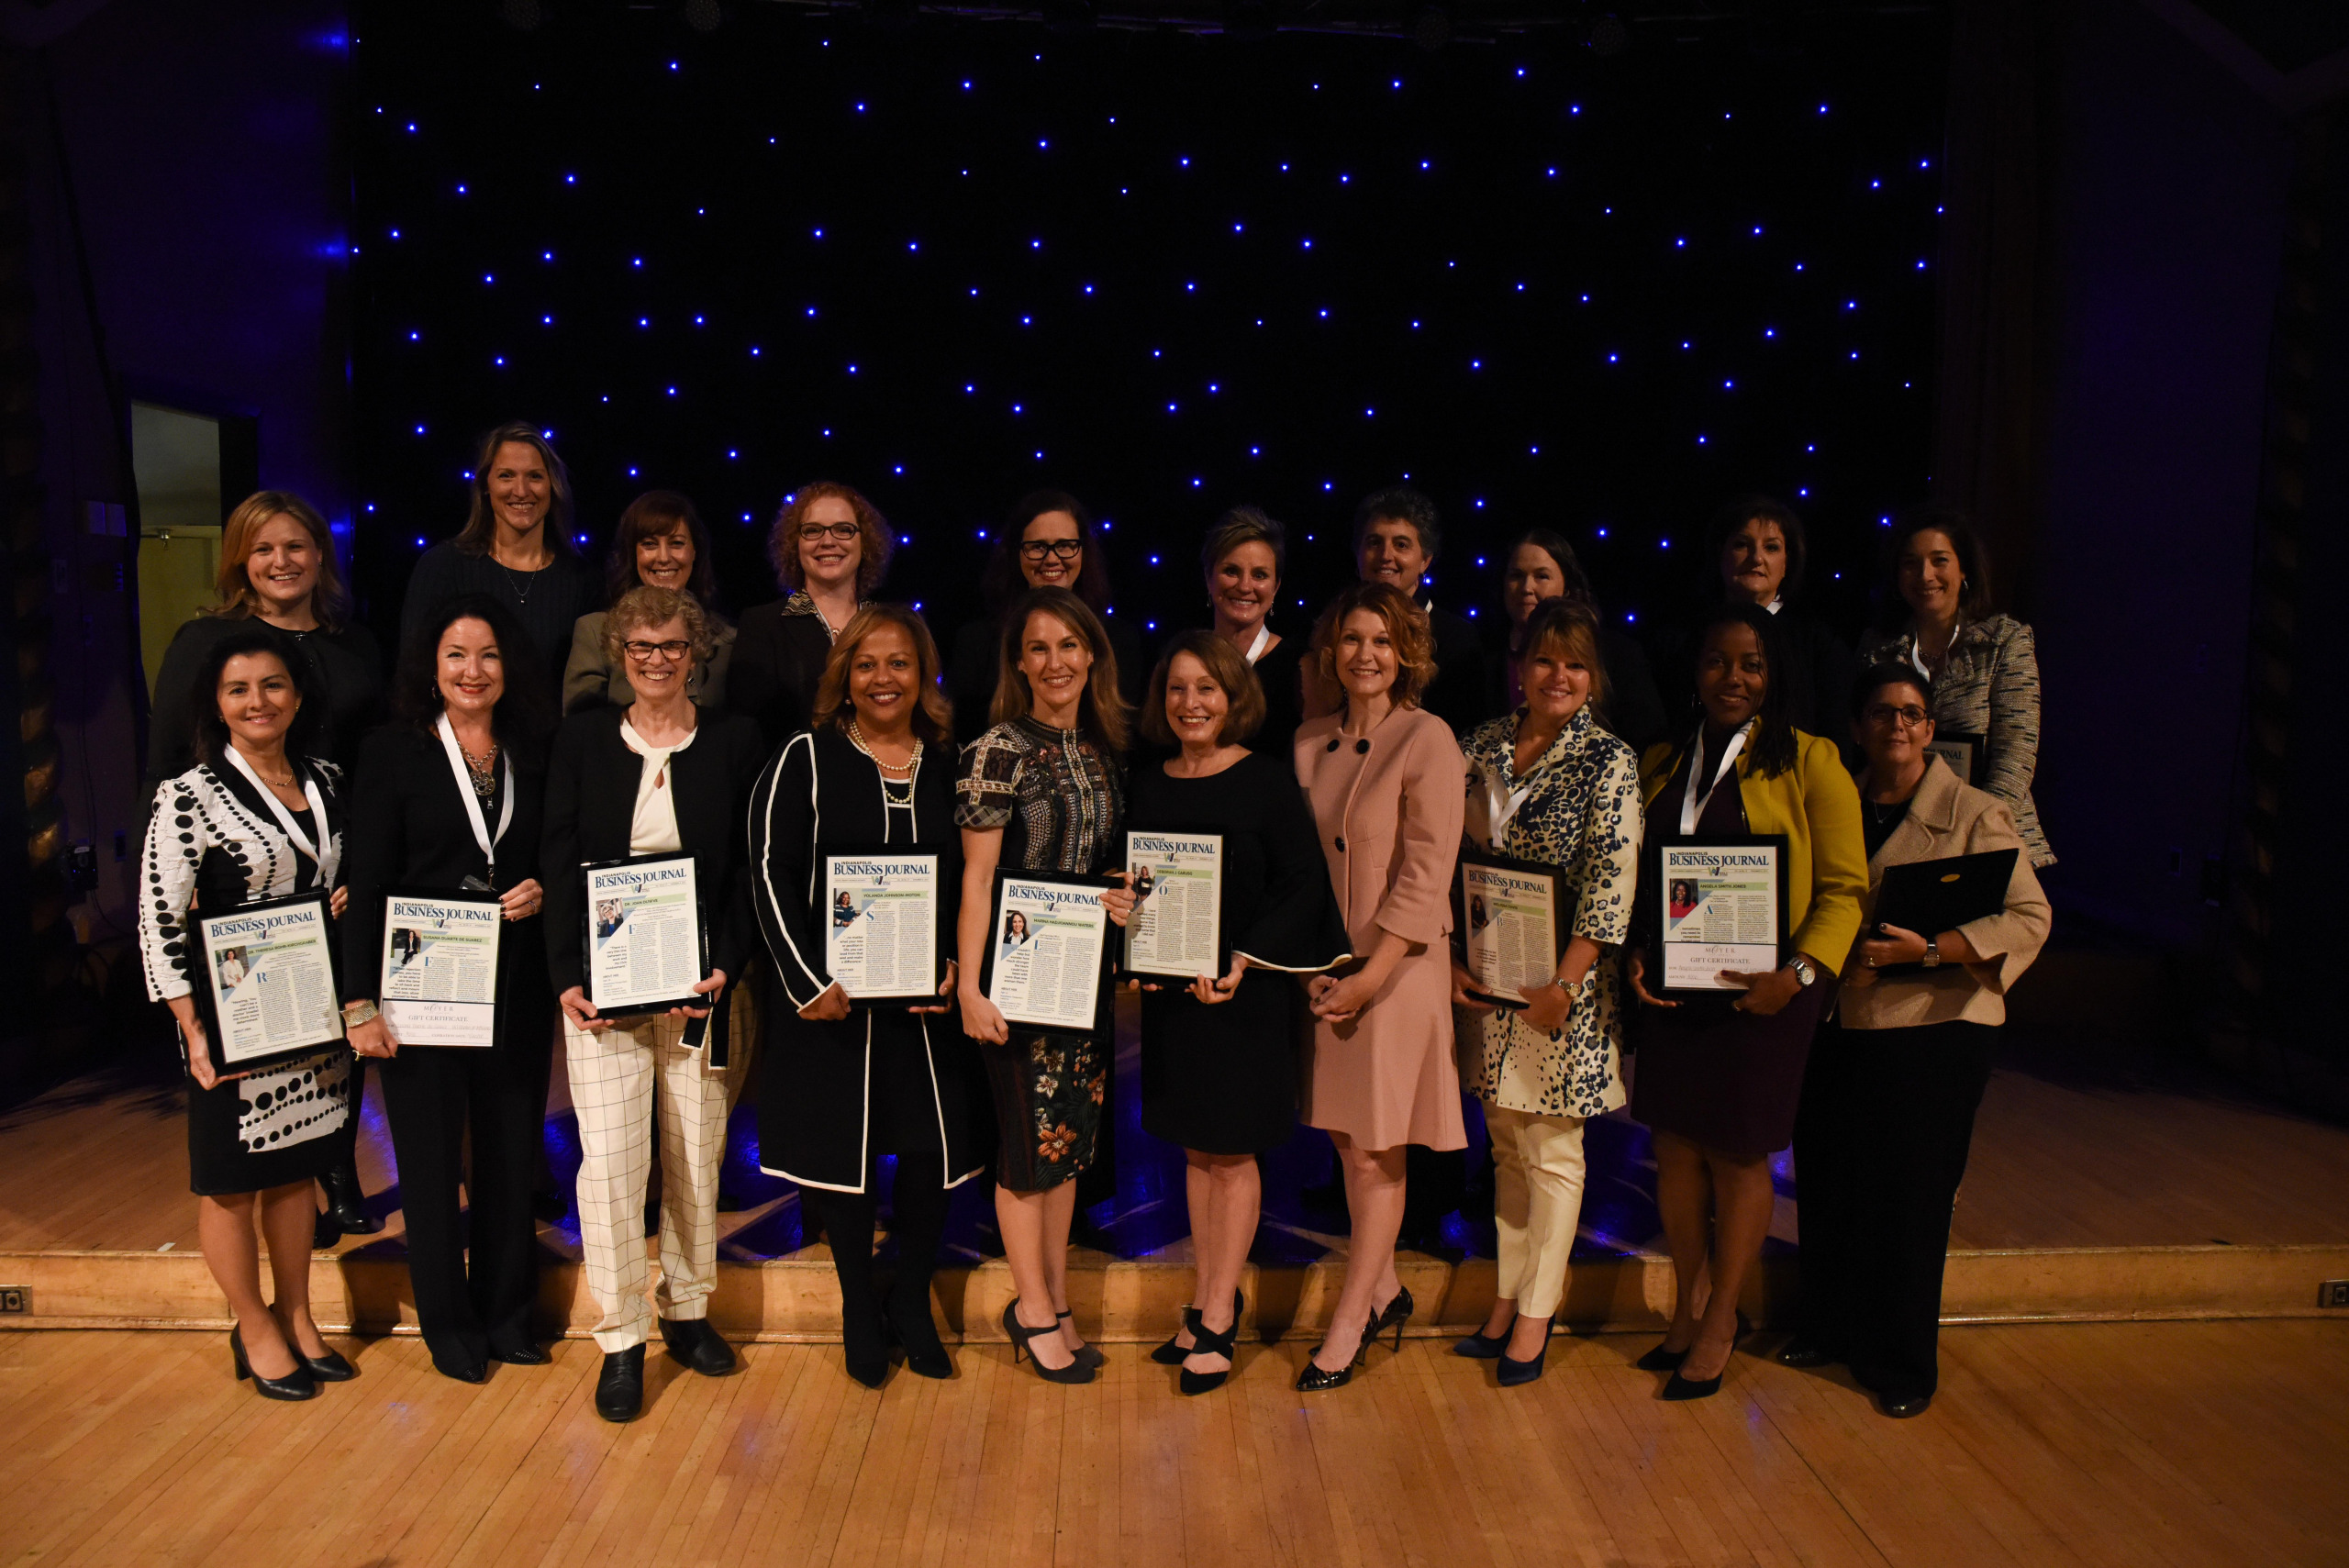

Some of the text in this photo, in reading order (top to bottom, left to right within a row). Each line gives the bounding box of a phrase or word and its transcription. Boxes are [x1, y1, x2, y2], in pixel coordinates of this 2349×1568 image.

[1133, 838, 1215, 853] BUSINESS JOURNAL
[834, 863, 930, 876] BUSINESS JOURNAL
[1669, 853, 1769, 867] BUSINESS JOURNAL
[595, 874, 642, 888] BUSINESS
[643, 868, 686, 884] JOURNAL
[1469, 870, 1507, 887] BUSINESS
[1509, 879, 1547, 893] JOURNAL
[1009, 885, 1055, 901] BUSINESS
[1056, 892, 1100, 905] JOURNAL
[394, 903, 493, 921] BUSINESS JOURNAL
[211, 912, 316, 937] BUSINESS JOURNAL
